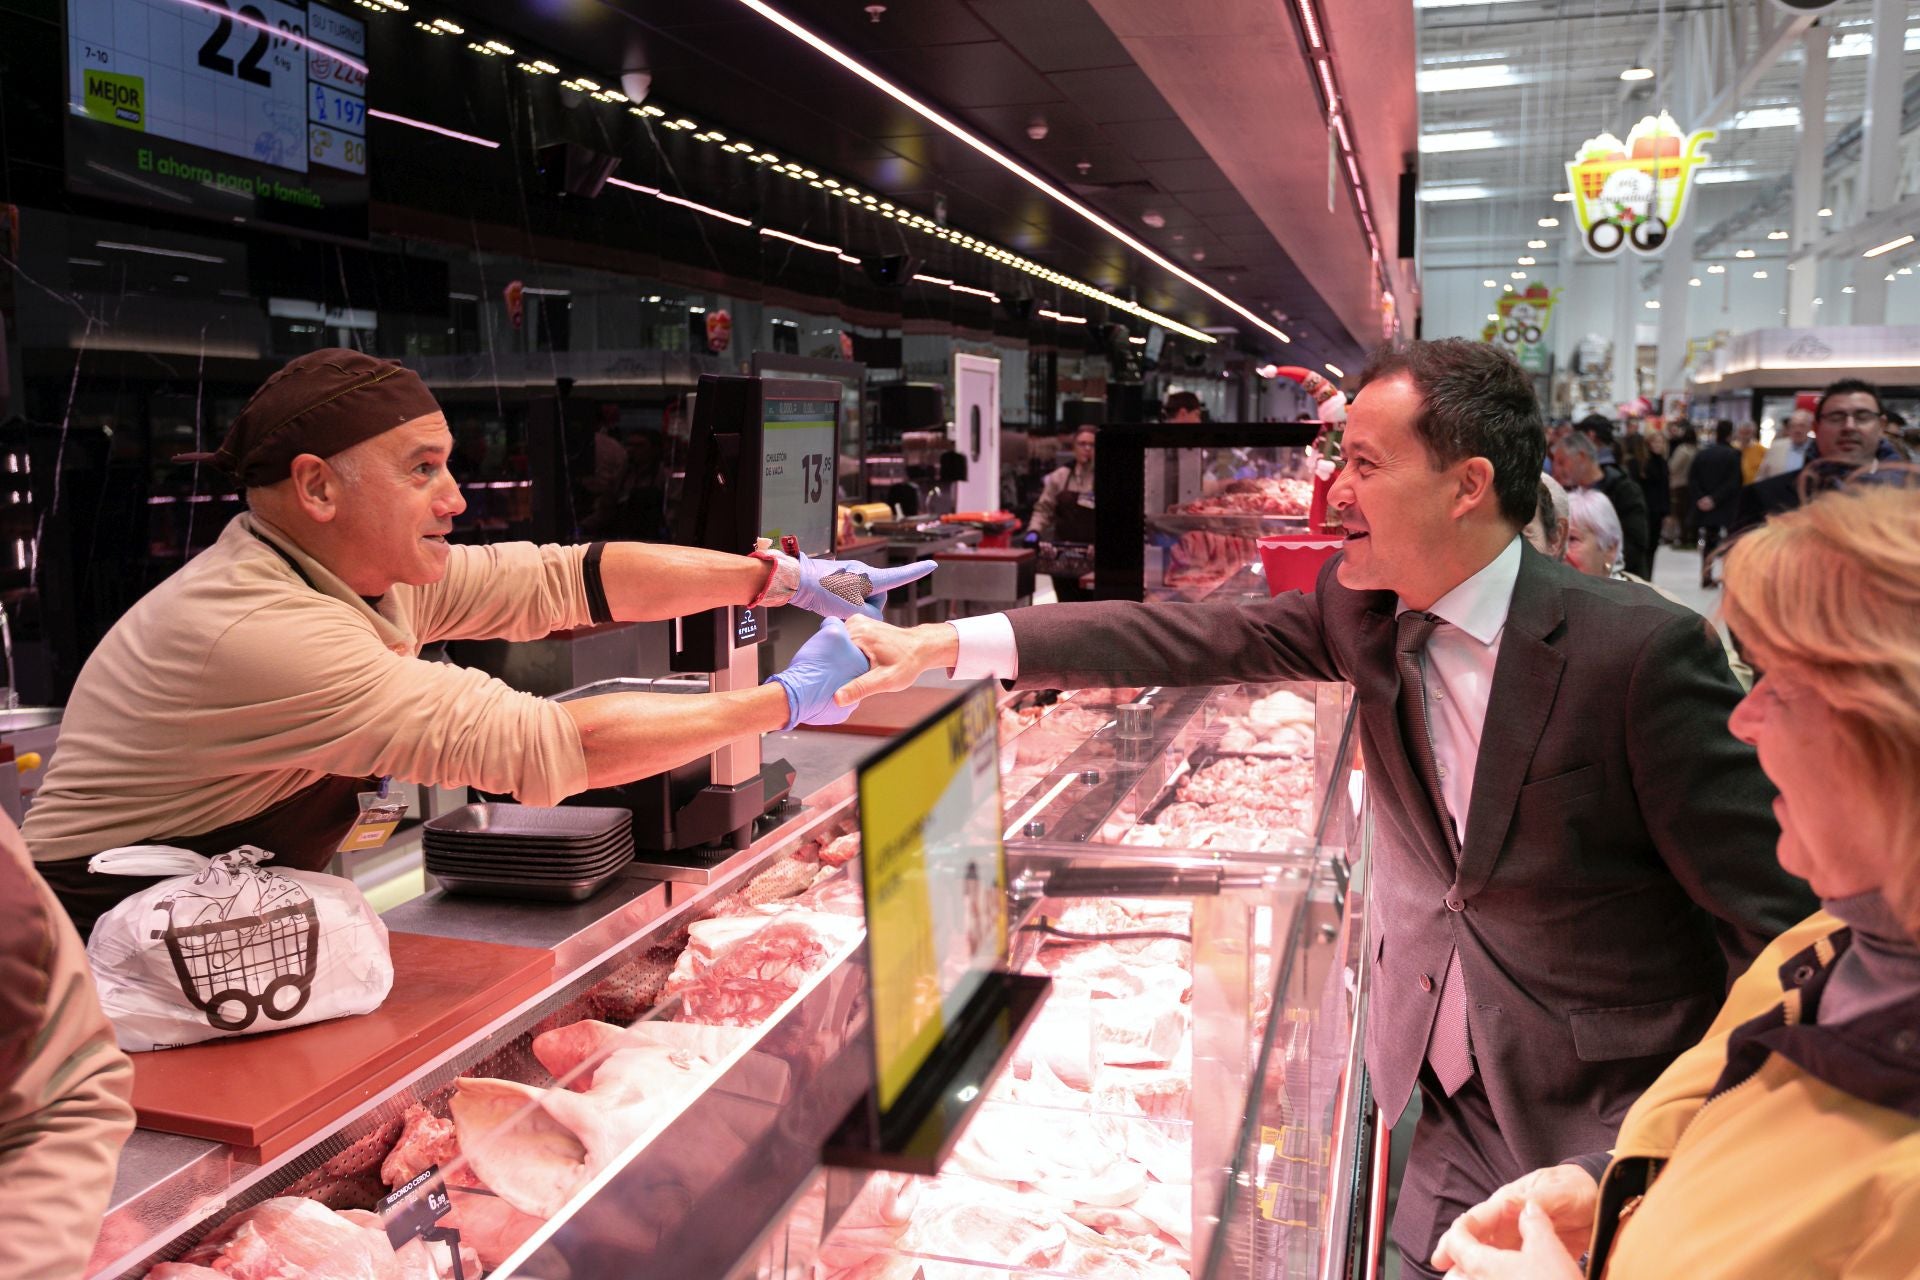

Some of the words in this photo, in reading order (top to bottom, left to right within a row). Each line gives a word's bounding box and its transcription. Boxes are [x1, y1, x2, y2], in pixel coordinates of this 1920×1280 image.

[312, 14, 326, 31] SU
[328, 20, 362, 45] TURNO
[85, 46, 108, 64] 7-10
[89, 77, 140, 108] MEJOR
[334, 98, 365, 126] 197
[345, 140, 365, 165] 80
[138, 149, 153, 171] El
[157, 156, 214, 183] ahorro
[217, 171, 253, 192] para
[256, 176, 271, 197] la
[386, 1183, 413, 1204] REDONDO
[412, 1170, 431, 1187] CERDO
[428, 1193, 446, 1211] 6,99
